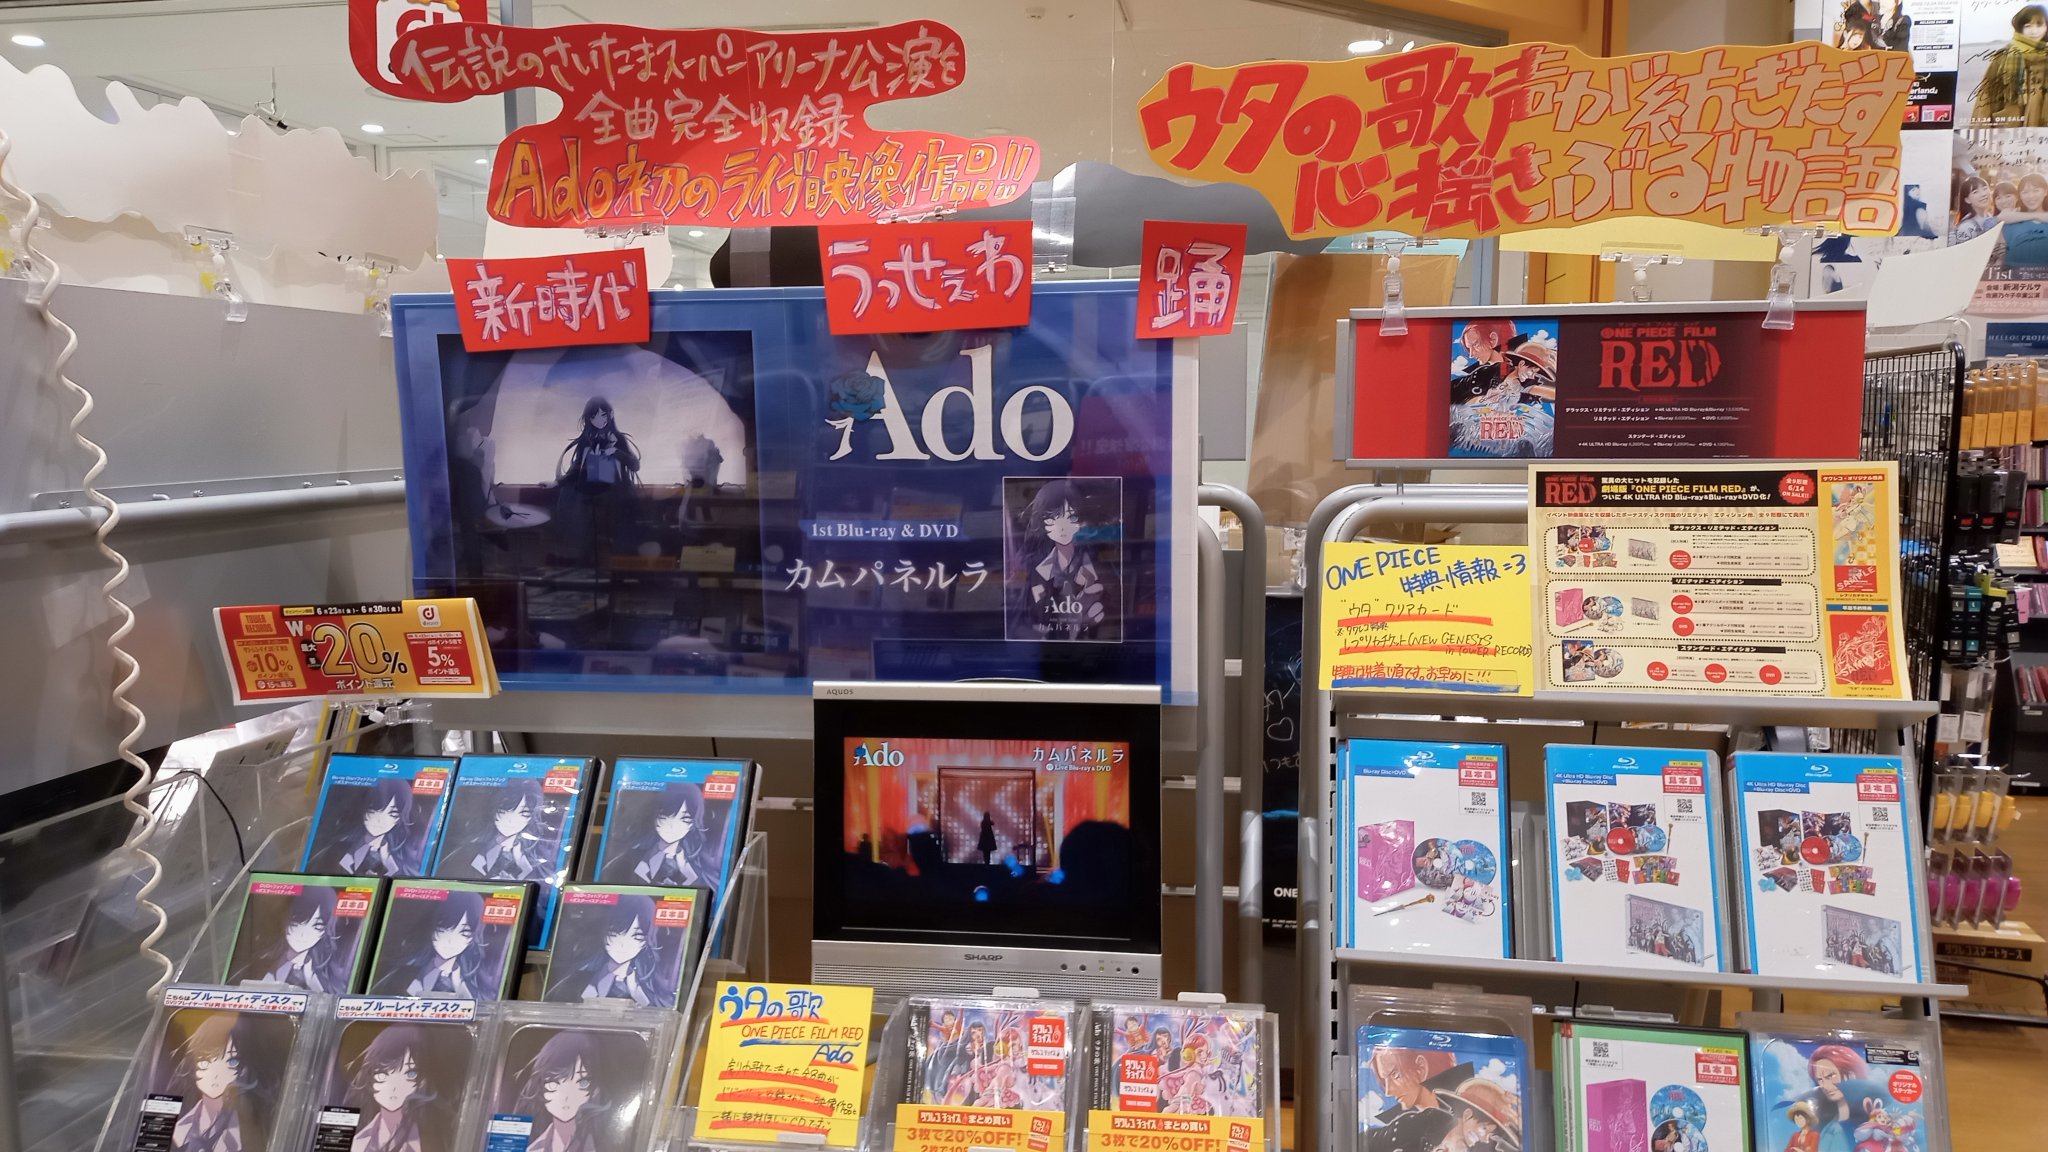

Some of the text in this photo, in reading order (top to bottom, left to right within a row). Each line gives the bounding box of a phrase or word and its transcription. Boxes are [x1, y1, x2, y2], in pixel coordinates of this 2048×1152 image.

[401, 26, 959, 94] 伝説のさいたまスーパーアリーナ公演を
[575, 91, 855, 144] 全曲完全収録
[1138, 44, 1912, 174] ウタの歌声が紡ぎだす
[499, 136, 1033, 221] Ado初のライブ映像作品!!
[1292, 126, 1901, 234] 心揺さぶる物語
[826, 228, 1023, 318] うっせぇわ
[1151, 241, 1231, 329] 踊
[465, 260, 639, 340] 新時代
[1601, 326, 1717, 339] ONE PIECE FILM
[1598, 339, 1722, 391] RED
[825, 345, 1074, 461] Ado
[1480, 421, 1525, 440] RED
[1544, 481, 1598, 504] RED
[1659, 485, 1690, 493] PIECE
[1692, 485, 1718, 493] FILM
[811, 523, 959, 541] 1st Blu-ray & DVD
[785, 559, 989, 593] カムパネルラ
[1326, 546, 1442, 591] ONE PIECE
[1044, 595, 1083, 614] Ado
[285, 620, 304, 637] W
[1441, 632, 1493, 646] GENESIS
[312, 623, 408, 677] 20%
[427, 646, 455, 667] 5%
[253, 653, 293, 673] 10%
[853, 741, 904, 768] Ado
[1032, 745, 1124, 764] カムパネルラ
[1273, 887, 1298, 898] ONE
[964, 953, 1003, 962] SHARP
[741, 1025, 864, 1041] ONE PIECE FILM RED
[814, 1043, 853, 1064] Ado
[968, 1114, 1011, 1125] まとめ買い
[1164, 1120, 1208, 1131] まとめ買い
[907, 1127, 1022, 1146] 3枚で20%OFF!
[1101, 1133, 1221, 1152] 3枚で20%OFF!
